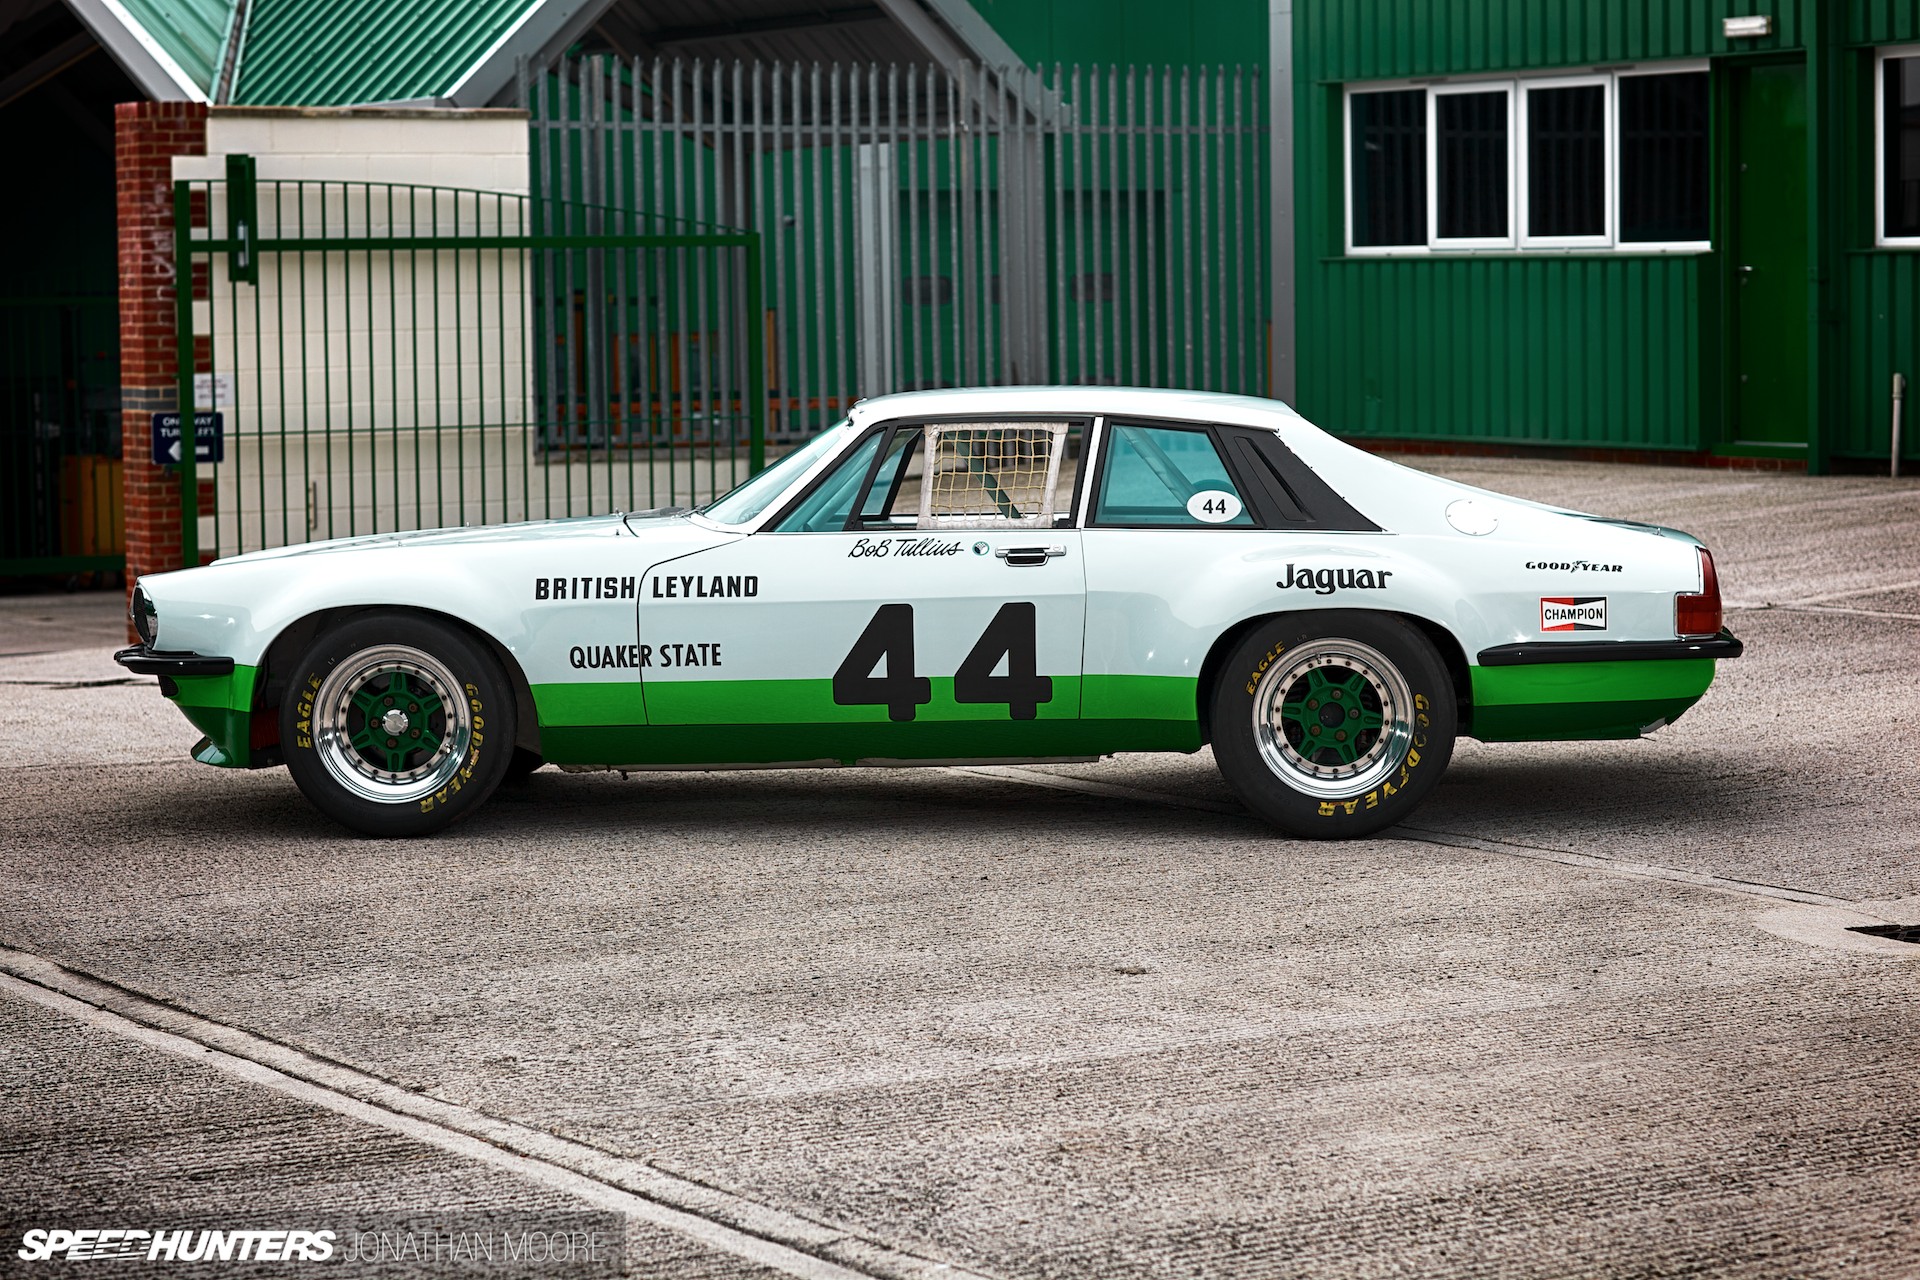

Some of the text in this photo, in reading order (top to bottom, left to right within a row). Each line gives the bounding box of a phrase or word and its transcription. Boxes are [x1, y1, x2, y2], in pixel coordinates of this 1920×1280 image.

[1202, 498, 1227, 514] 44
[893, 537, 964, 557] Tullius
[535, 575, 759, 600] BRITISH LEYLAND
[1276, 563, 1393, 595] Jaguar
[1544, 608, 1603, 620] CHAMPION
[569, 643, 722, 669] QUAKER STATE
[832, 602, 1053, 722] 44
[1245, 640, 1286, 696] EAGLE
[296, 673, 323, 749] EAGLE
